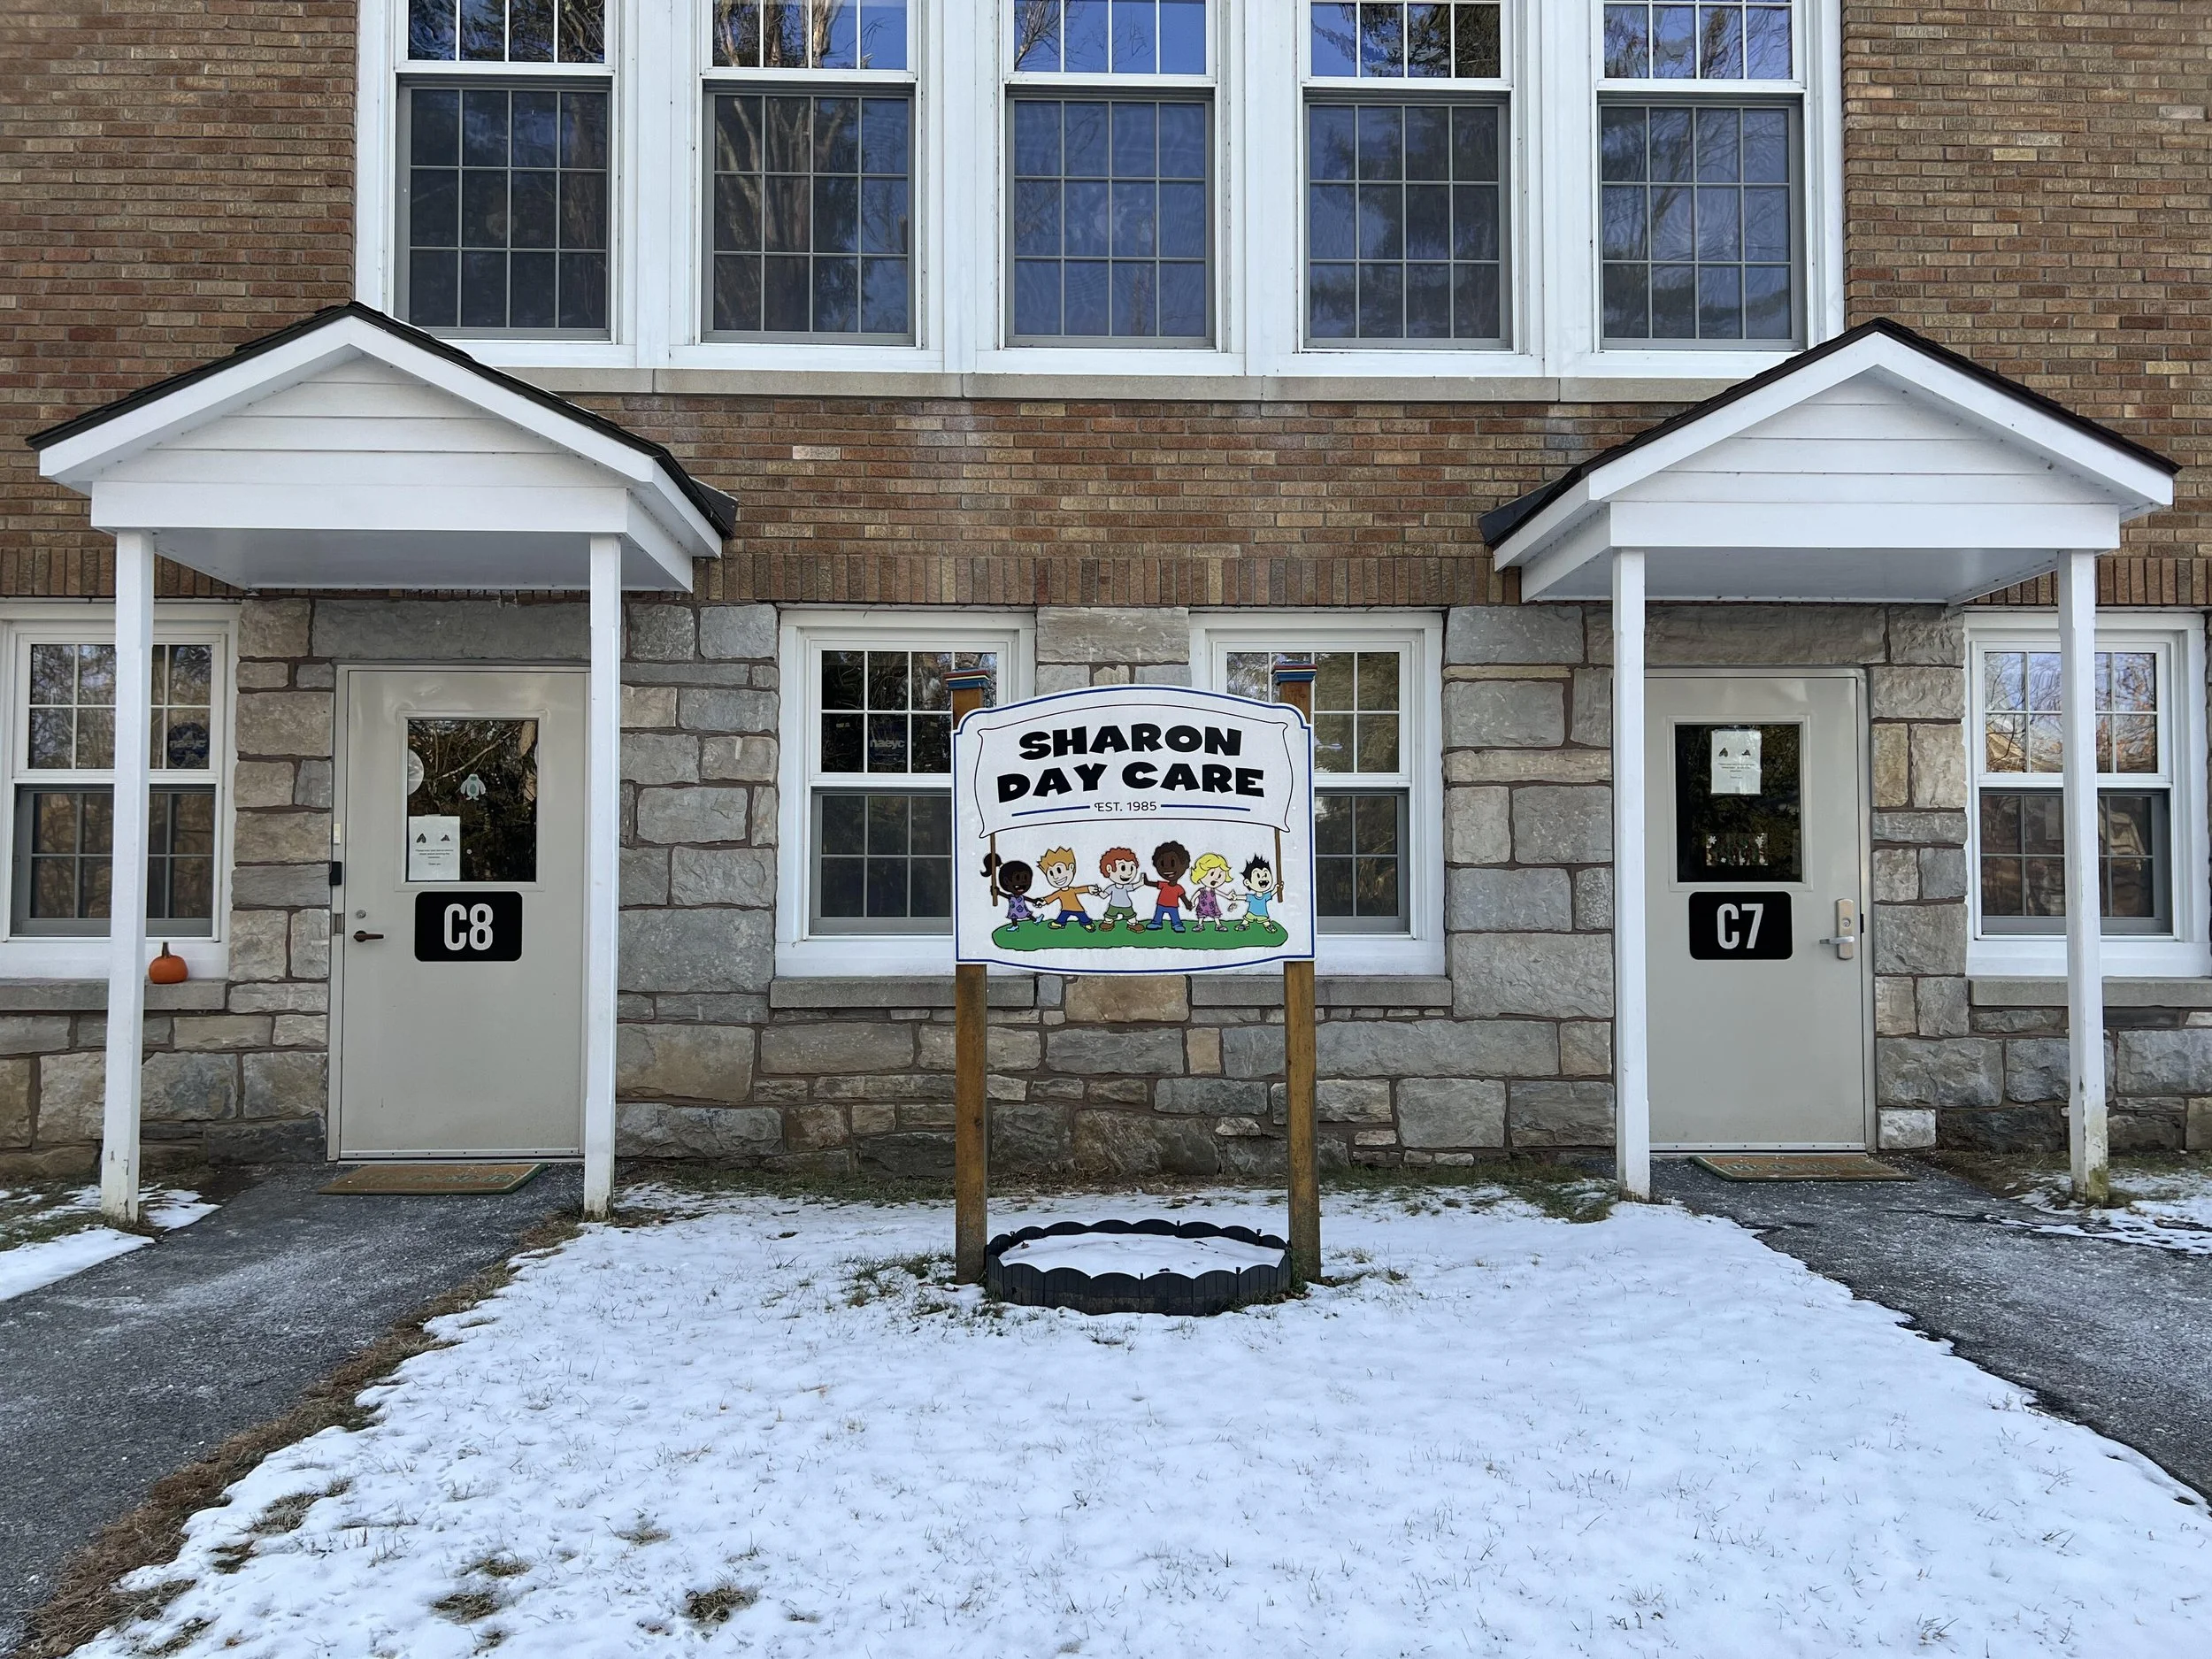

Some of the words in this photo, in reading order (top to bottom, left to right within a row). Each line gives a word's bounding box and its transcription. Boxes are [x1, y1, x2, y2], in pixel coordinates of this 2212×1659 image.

[870, 739, 905, 749] naeyc
[1019, 724, 1242, 760] SHARON
[997, 763, 1108, 803] DAY
[1122, 762, 1264, 797] CARE
[1094, 802, 1123, 812] EST.
[1126, 801, 1157, 811] 1985
[444, 903, 493, 951] C8
[1717, 903, 1763, 949] C7
